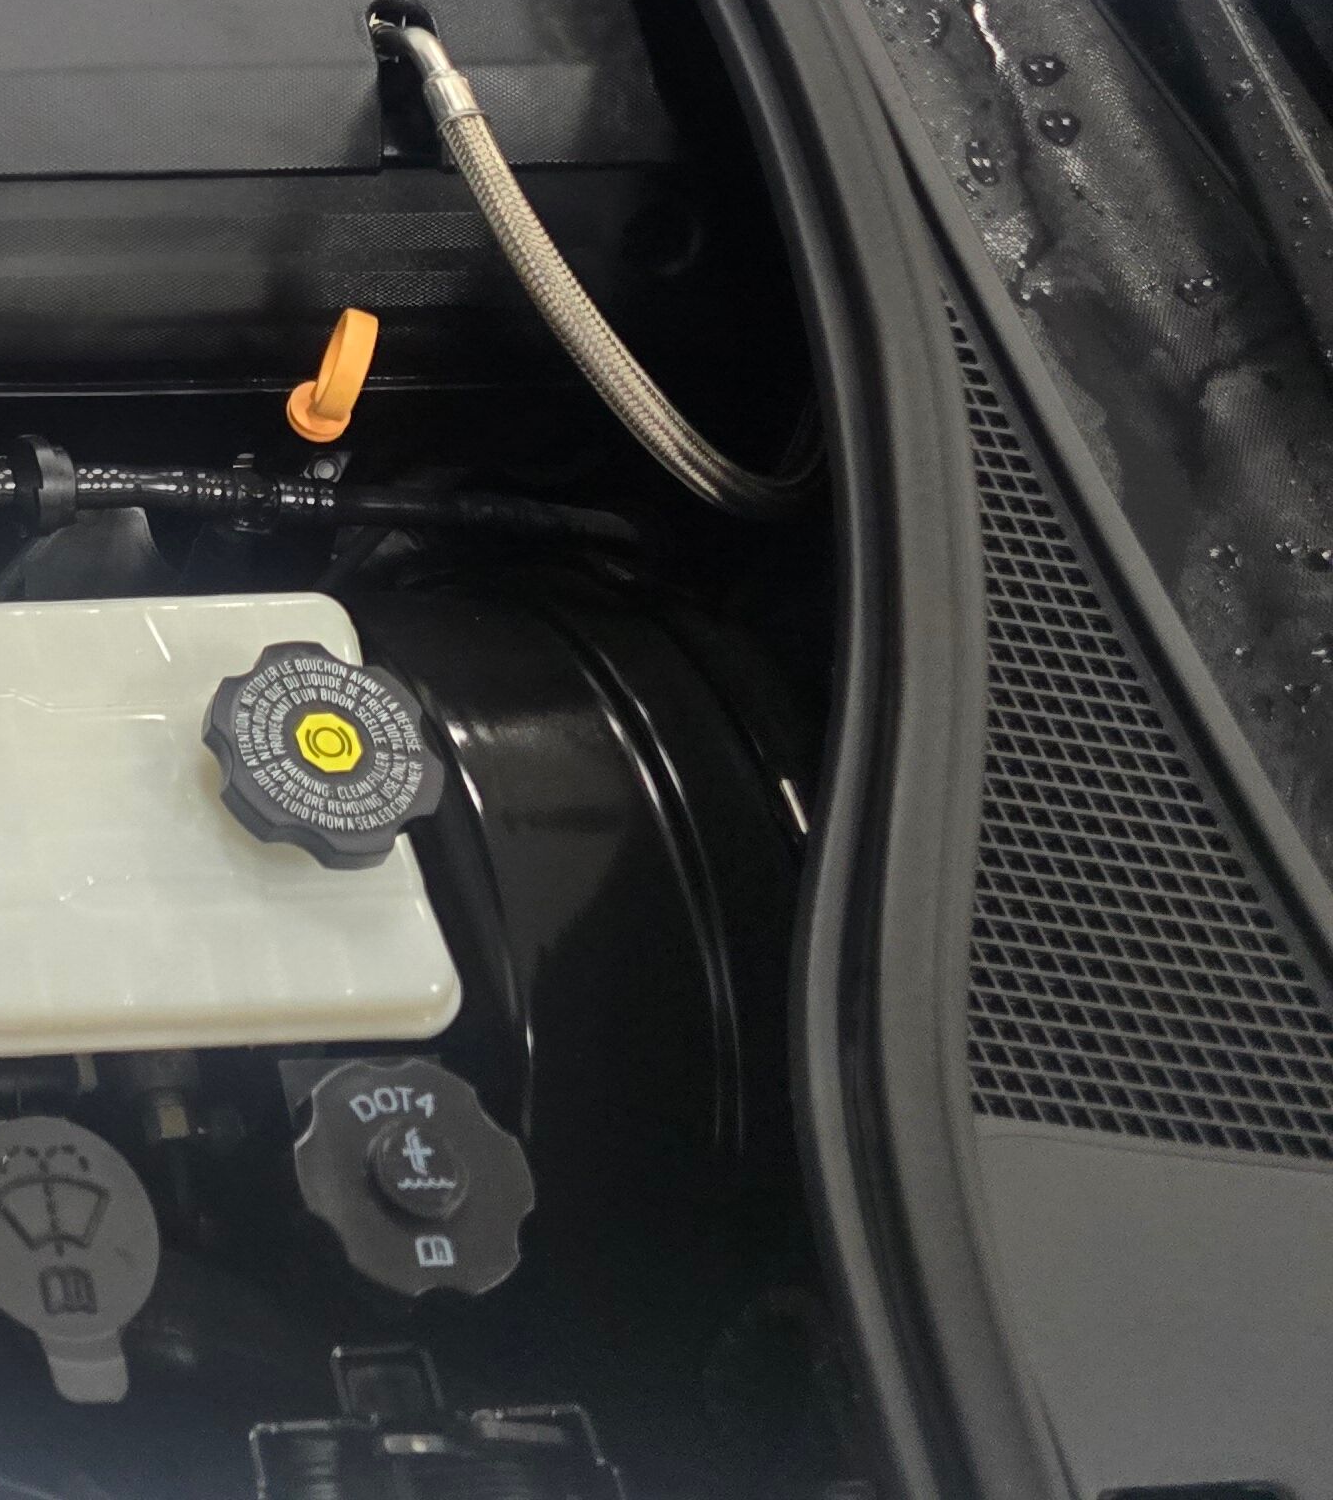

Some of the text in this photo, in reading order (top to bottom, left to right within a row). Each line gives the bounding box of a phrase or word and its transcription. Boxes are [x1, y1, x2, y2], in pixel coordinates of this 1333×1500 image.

[264, 681, 286, 702] QUE
[283, 674, 300, 690] DU
[301, 673, 342, 690] LIQUIDE
[345, 682, 361, 698] DE
[361, 693, 391, 723] FREIN
[277, 660, 294, 676] LE
[294, 658, 348, 678] BOUCHON
[349, 670, 386, 697] AVANT
[381, 695, 400, 712] LA
[320, 687, 355, 711] BIDON
[354, 706, 388, 747] SCELLE
[253, 761, 423, 831] DOT4 FLUID FROM A SEALED CONTAINER
[265, 762, 287, 781] CAP
[283, 780, 325, 810] BEFORE
[378, 777, 400, 799] USE
[390, 753, 407, 781] ONLY
[336, 781, 373, 800] CLEAN
[366, 752, 390, 788] FILLER
[349, 1086, 436, 1123] DOT4
